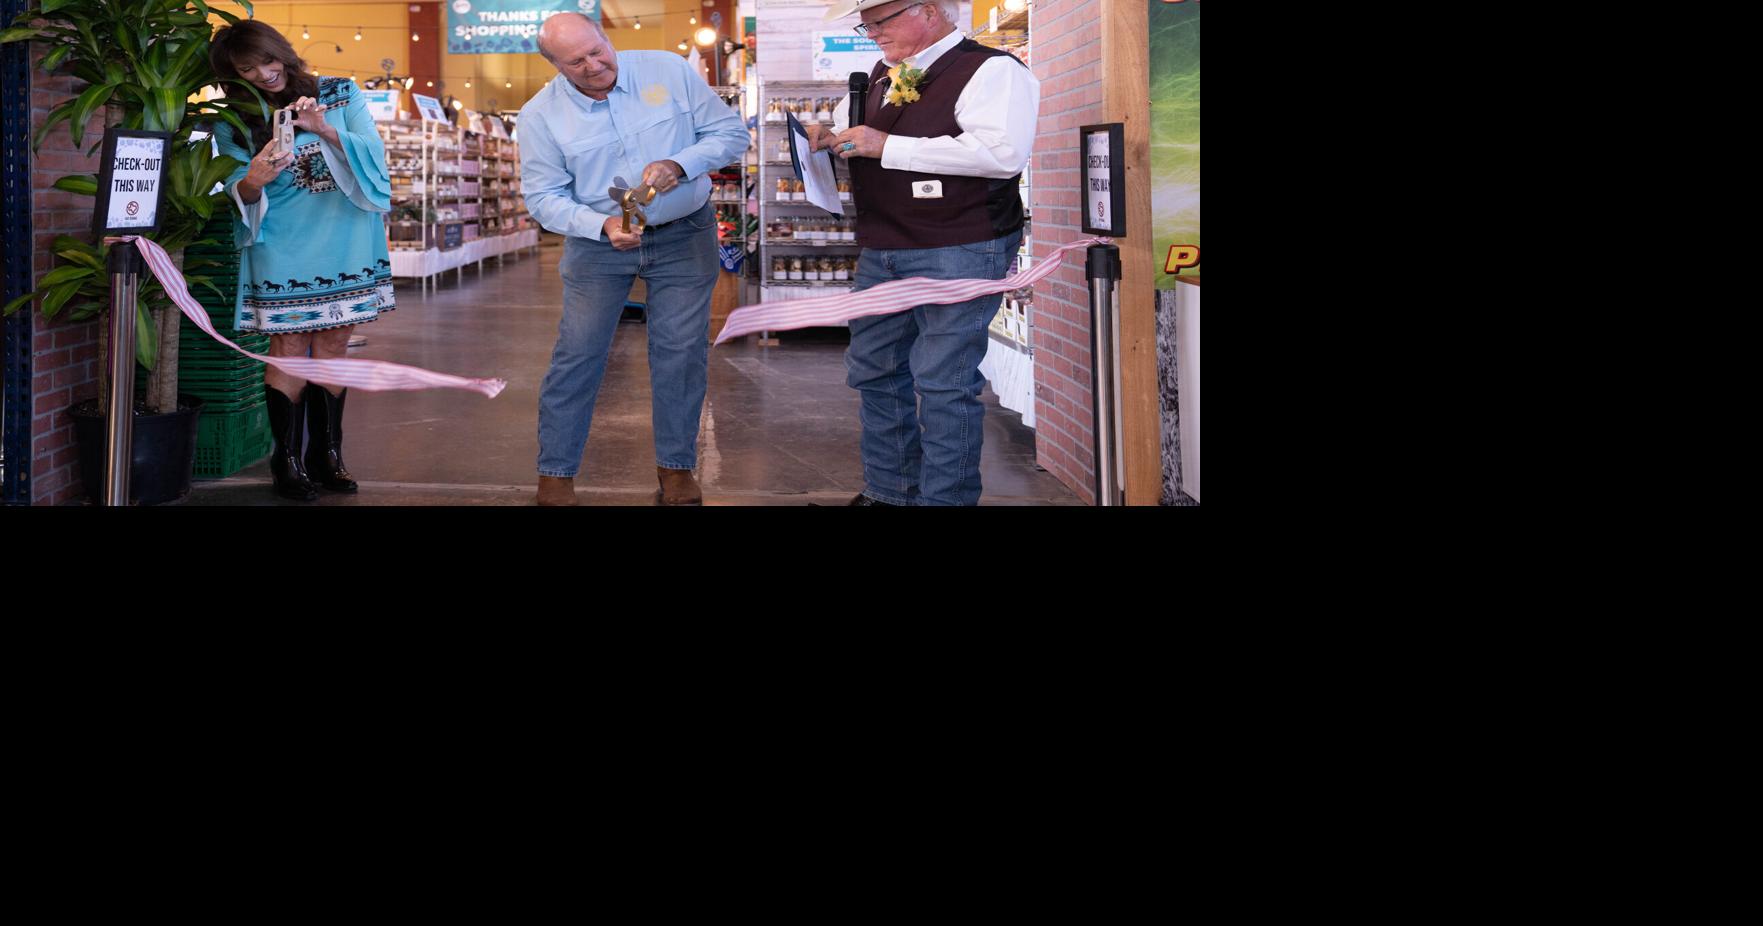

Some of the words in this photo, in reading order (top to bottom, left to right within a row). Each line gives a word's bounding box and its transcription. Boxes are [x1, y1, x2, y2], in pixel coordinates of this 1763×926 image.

[479, 11, 538, 22] THANKS
[455, 24, 538, 36] SHOPPING
[113, 157, 161, 171] CHECK-OUT
[114, 179, 134, 193] THIS
[136, 179, 155, 193] WAY
[1090, 178, 1100, 192] THIS
